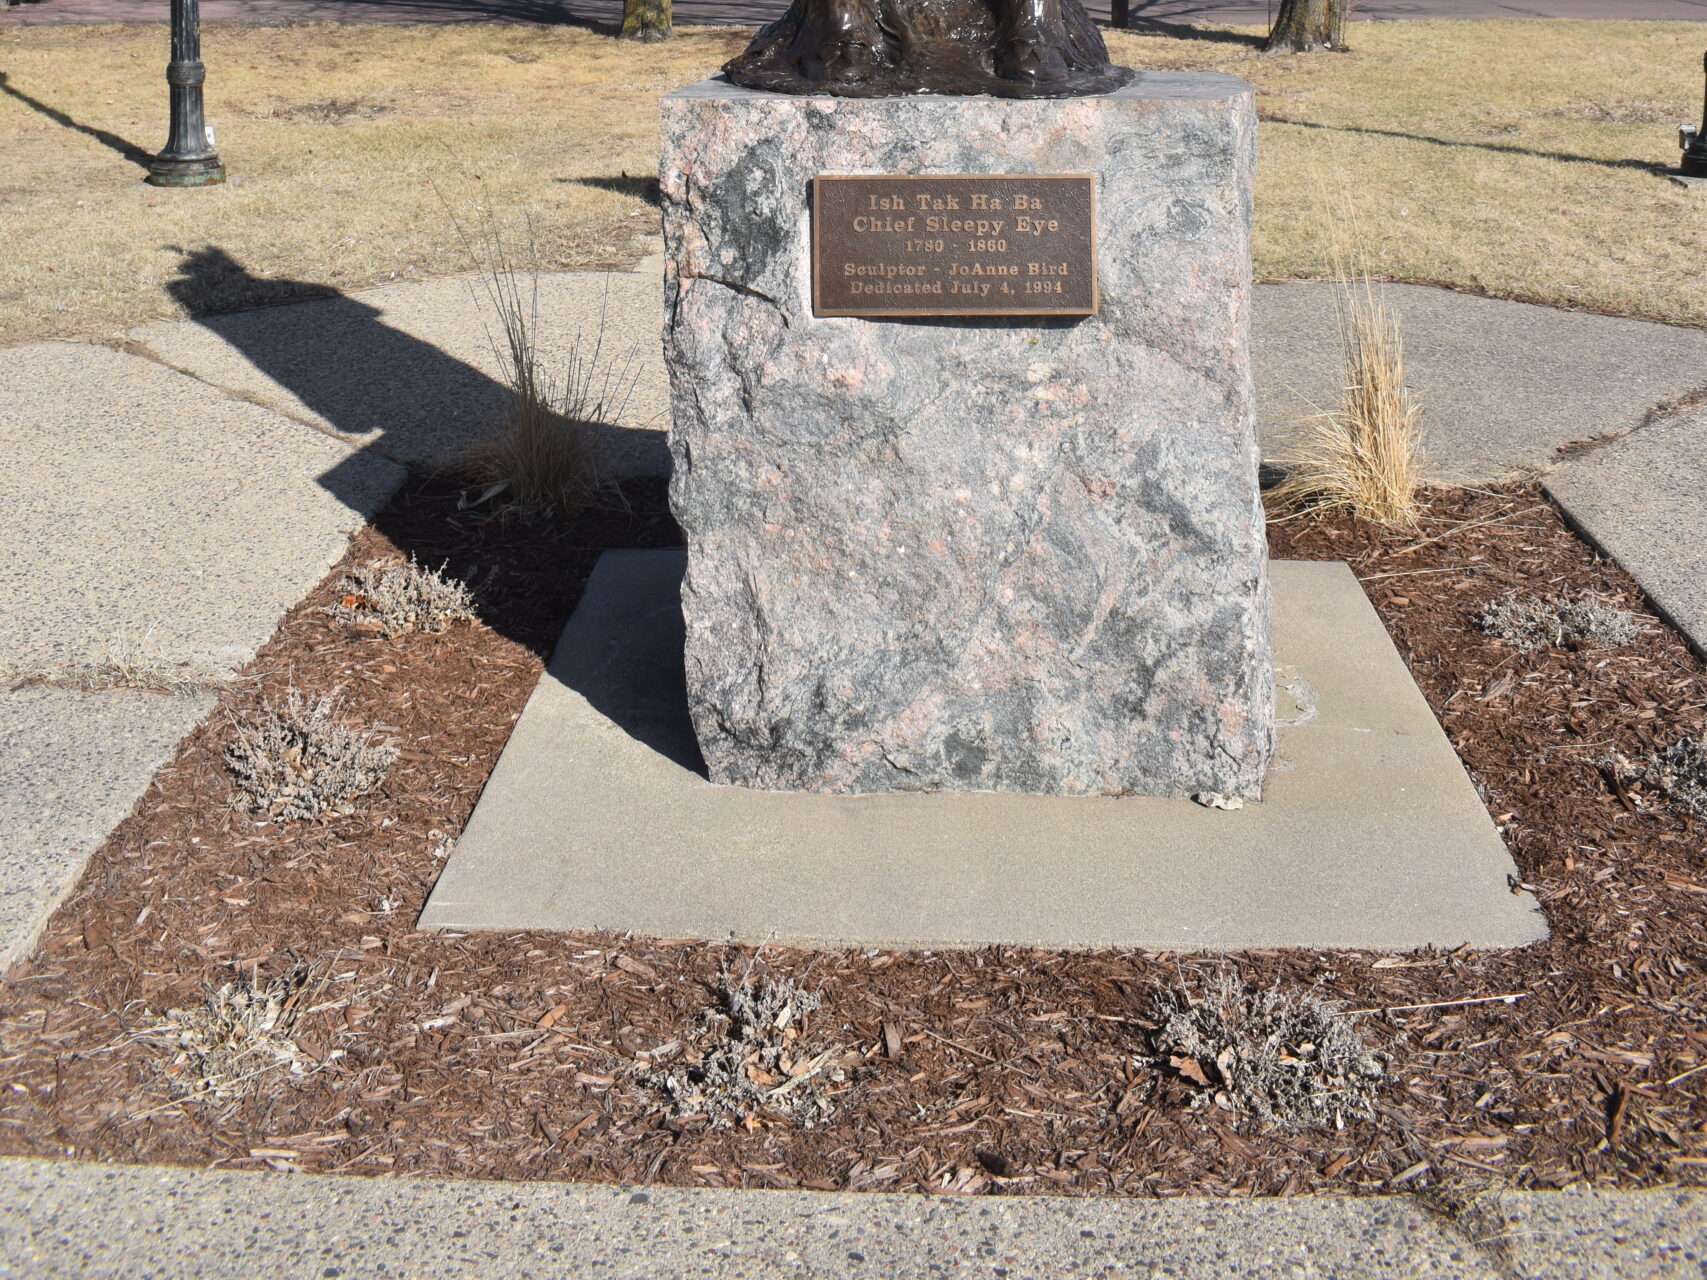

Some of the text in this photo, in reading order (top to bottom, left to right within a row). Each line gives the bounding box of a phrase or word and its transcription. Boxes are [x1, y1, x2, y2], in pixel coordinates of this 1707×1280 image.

[869, 194, 1042, 210] Ish Tak Ha Ba
[853, 216, 1059, 236] Chief Sleepy Eye
[906, 239, 943, 252] 1780
[969, 239, 1007, 252] 1860
[845, 263, 927, 280] Sculptor
[949, 263, 1019, 276] JoAnne
[1027, 263, 1068, 276] Bird
[851, 281, 1063, 297] Dedicated July 4, 1994
